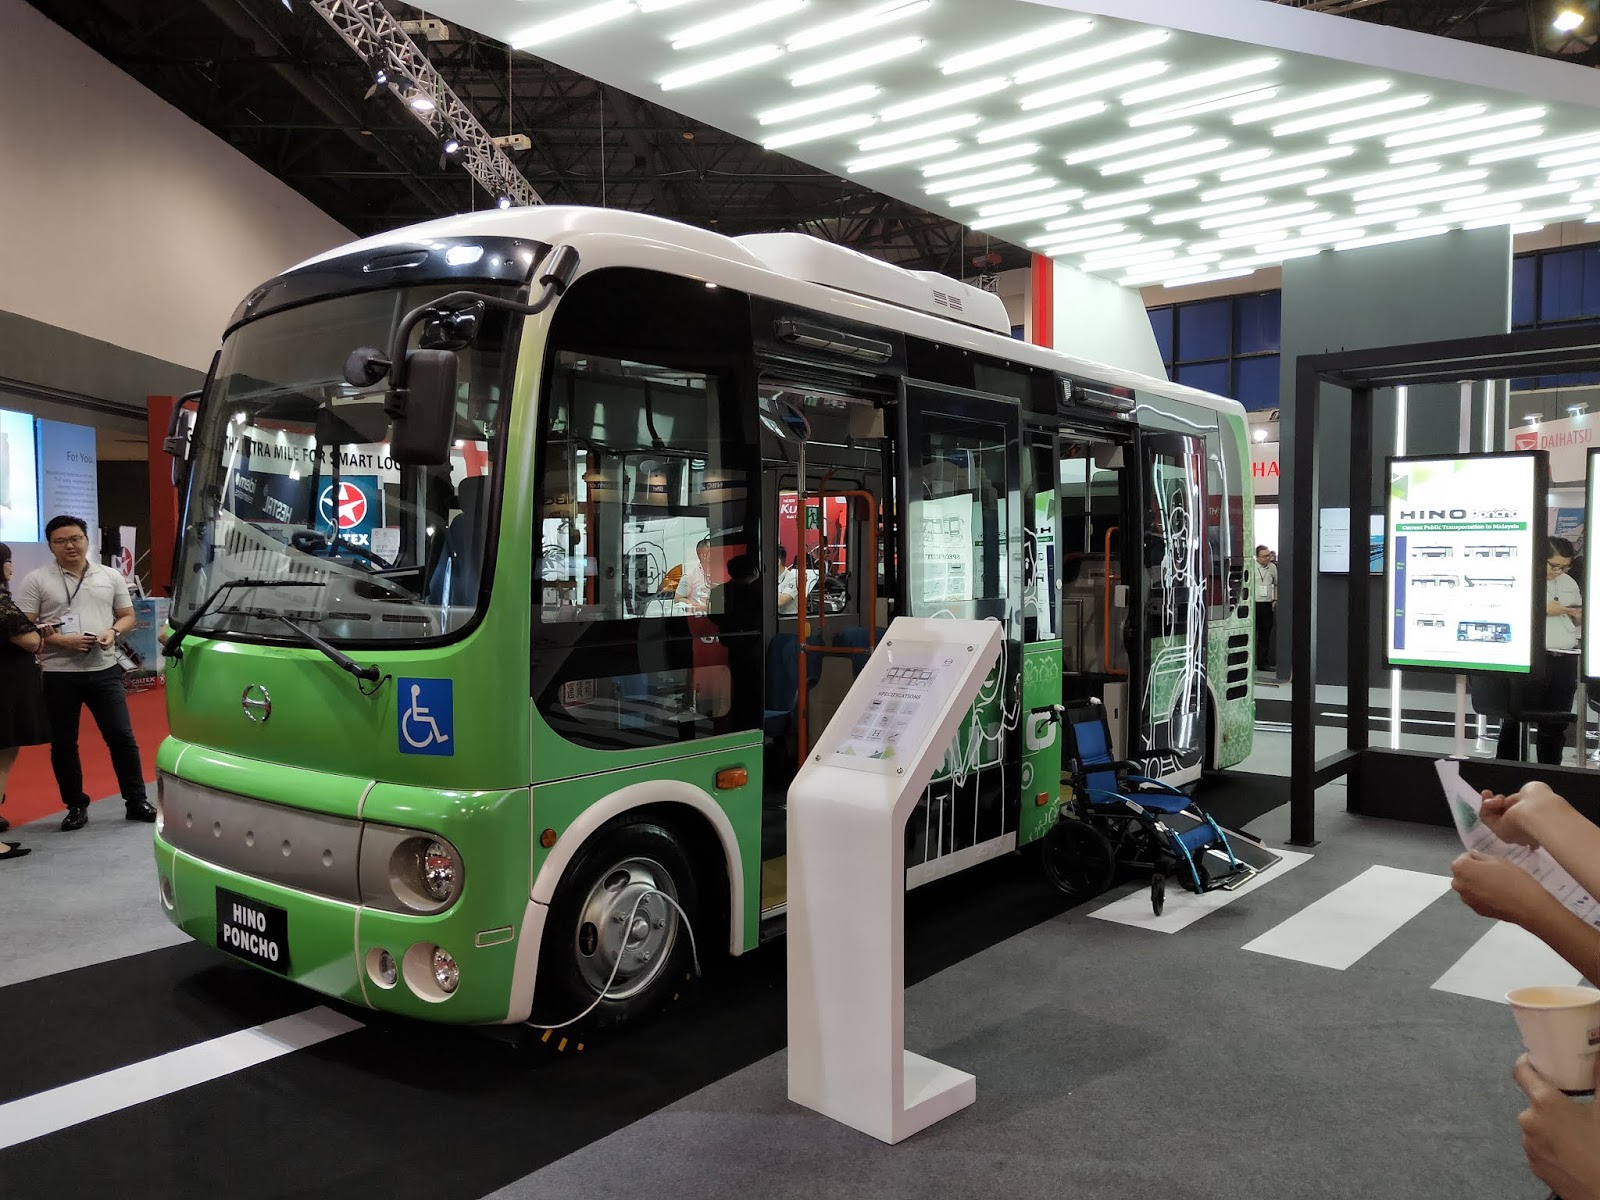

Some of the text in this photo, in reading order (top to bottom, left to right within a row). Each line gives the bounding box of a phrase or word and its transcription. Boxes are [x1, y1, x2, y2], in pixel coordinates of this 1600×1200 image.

[1541, 429, 1592, 449] DAIHATSU
[66, 451, 78, 461] For
[274, 445, 299, 461] MILE
[1400, 509, 1467, 519] HINO
[1442, 523, 1485, 531] Transportation
[1493, 522, 1520, 531] Malaysia
[131, 676, 155, 684] CALTEX
[878, 691, 921, 699] SPECIFICATIONS
[233, 903, 266, 932] HINO
[223, 923, 279, 961] PONCHO
